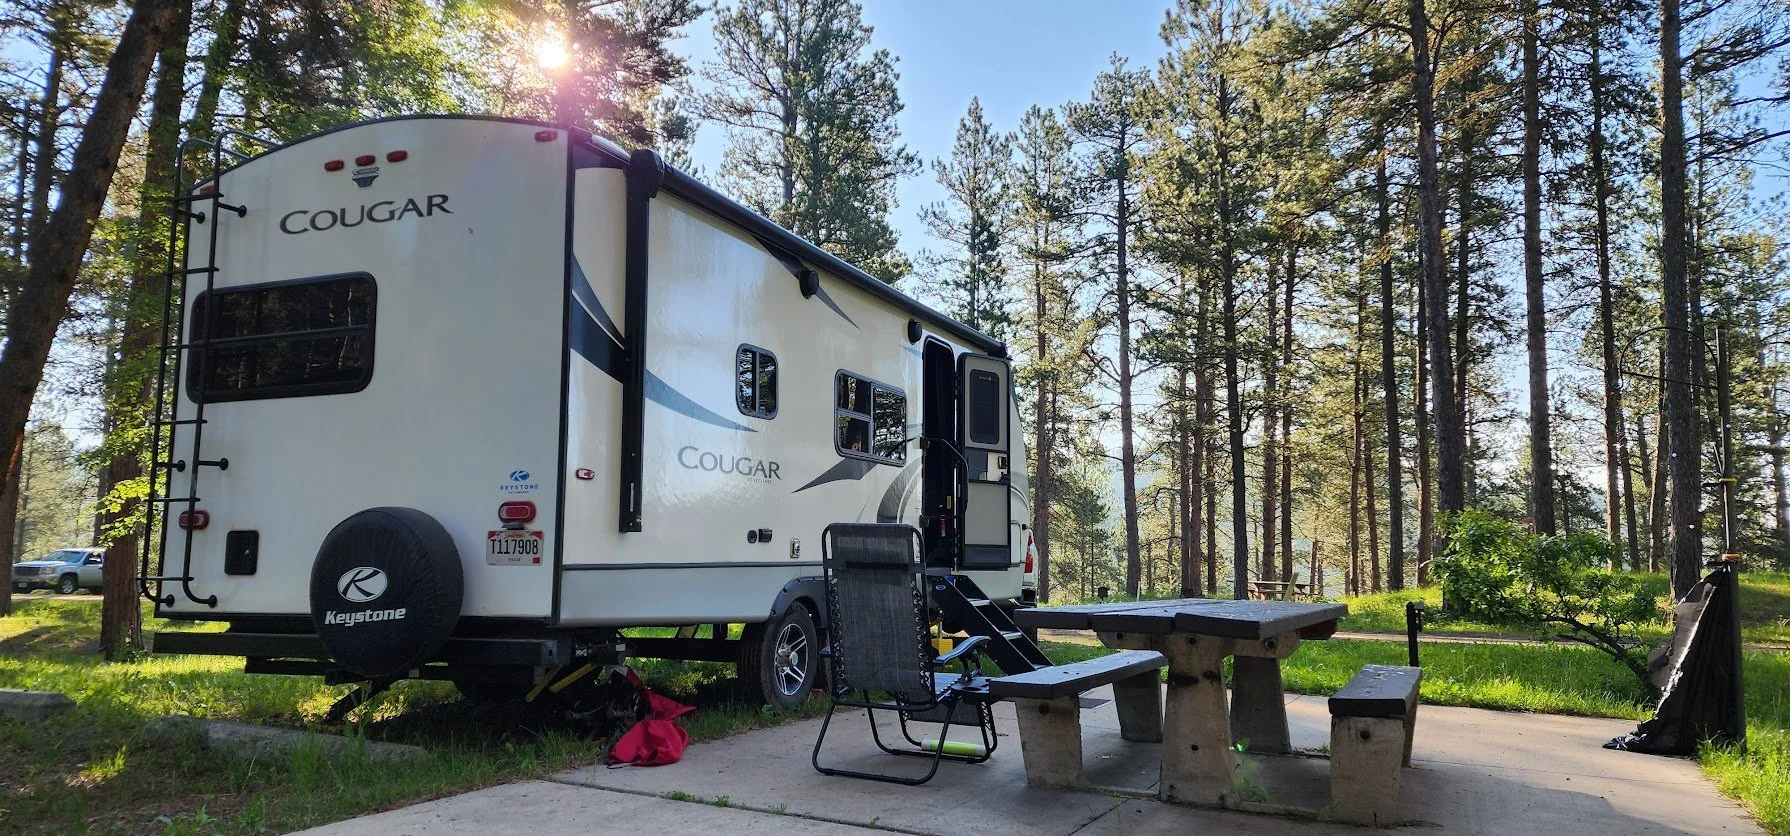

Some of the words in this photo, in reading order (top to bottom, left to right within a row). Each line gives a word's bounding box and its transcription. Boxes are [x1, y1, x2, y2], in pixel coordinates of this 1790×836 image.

[279, 194, 454, 235] COUGAR
[677, 446, 782, 480] COUGAR
[490, 539, 539, 555] T117908
[324, 607, 406, 627] Keystone
